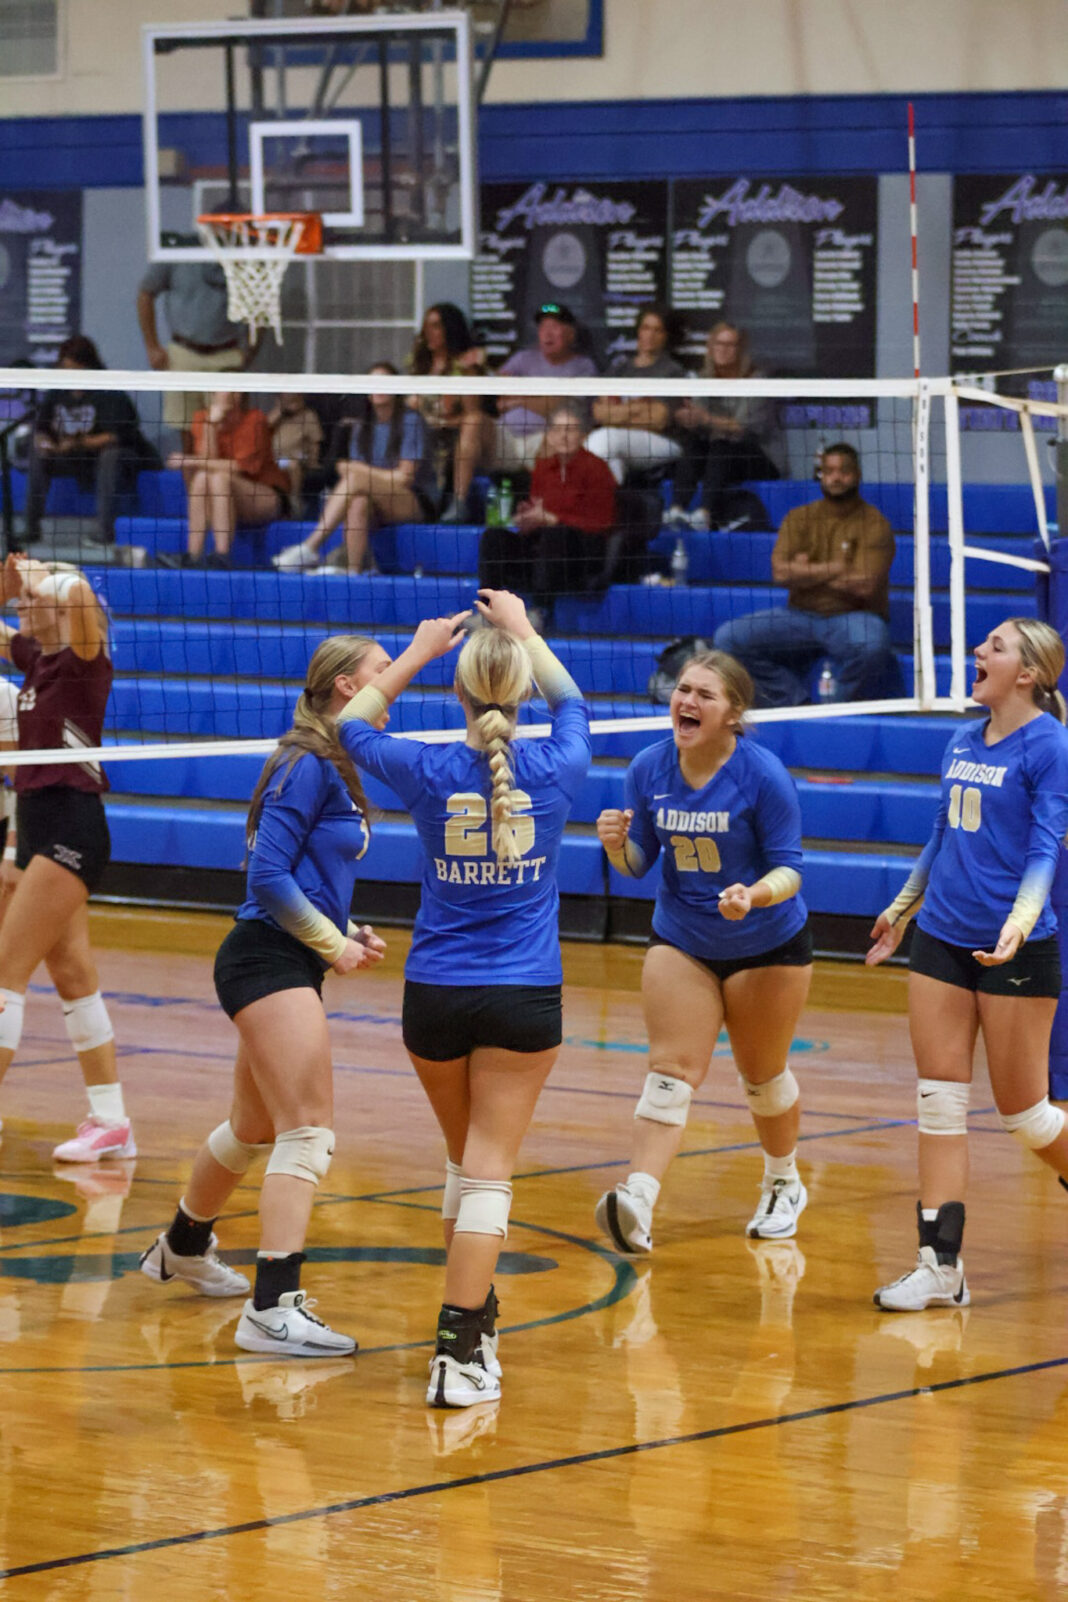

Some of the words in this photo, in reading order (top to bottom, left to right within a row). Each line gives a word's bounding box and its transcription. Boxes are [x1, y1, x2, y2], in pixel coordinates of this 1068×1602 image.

[945, 758, 1008, 788] ADDISON
[444, 788, 536, 857] 26
[656, 807, 730, 833] ADDISON
[948, 784, 982, 833] 10
[433, 856, 547, 884] BARRETT
[670, 835, 722, 873] 20
